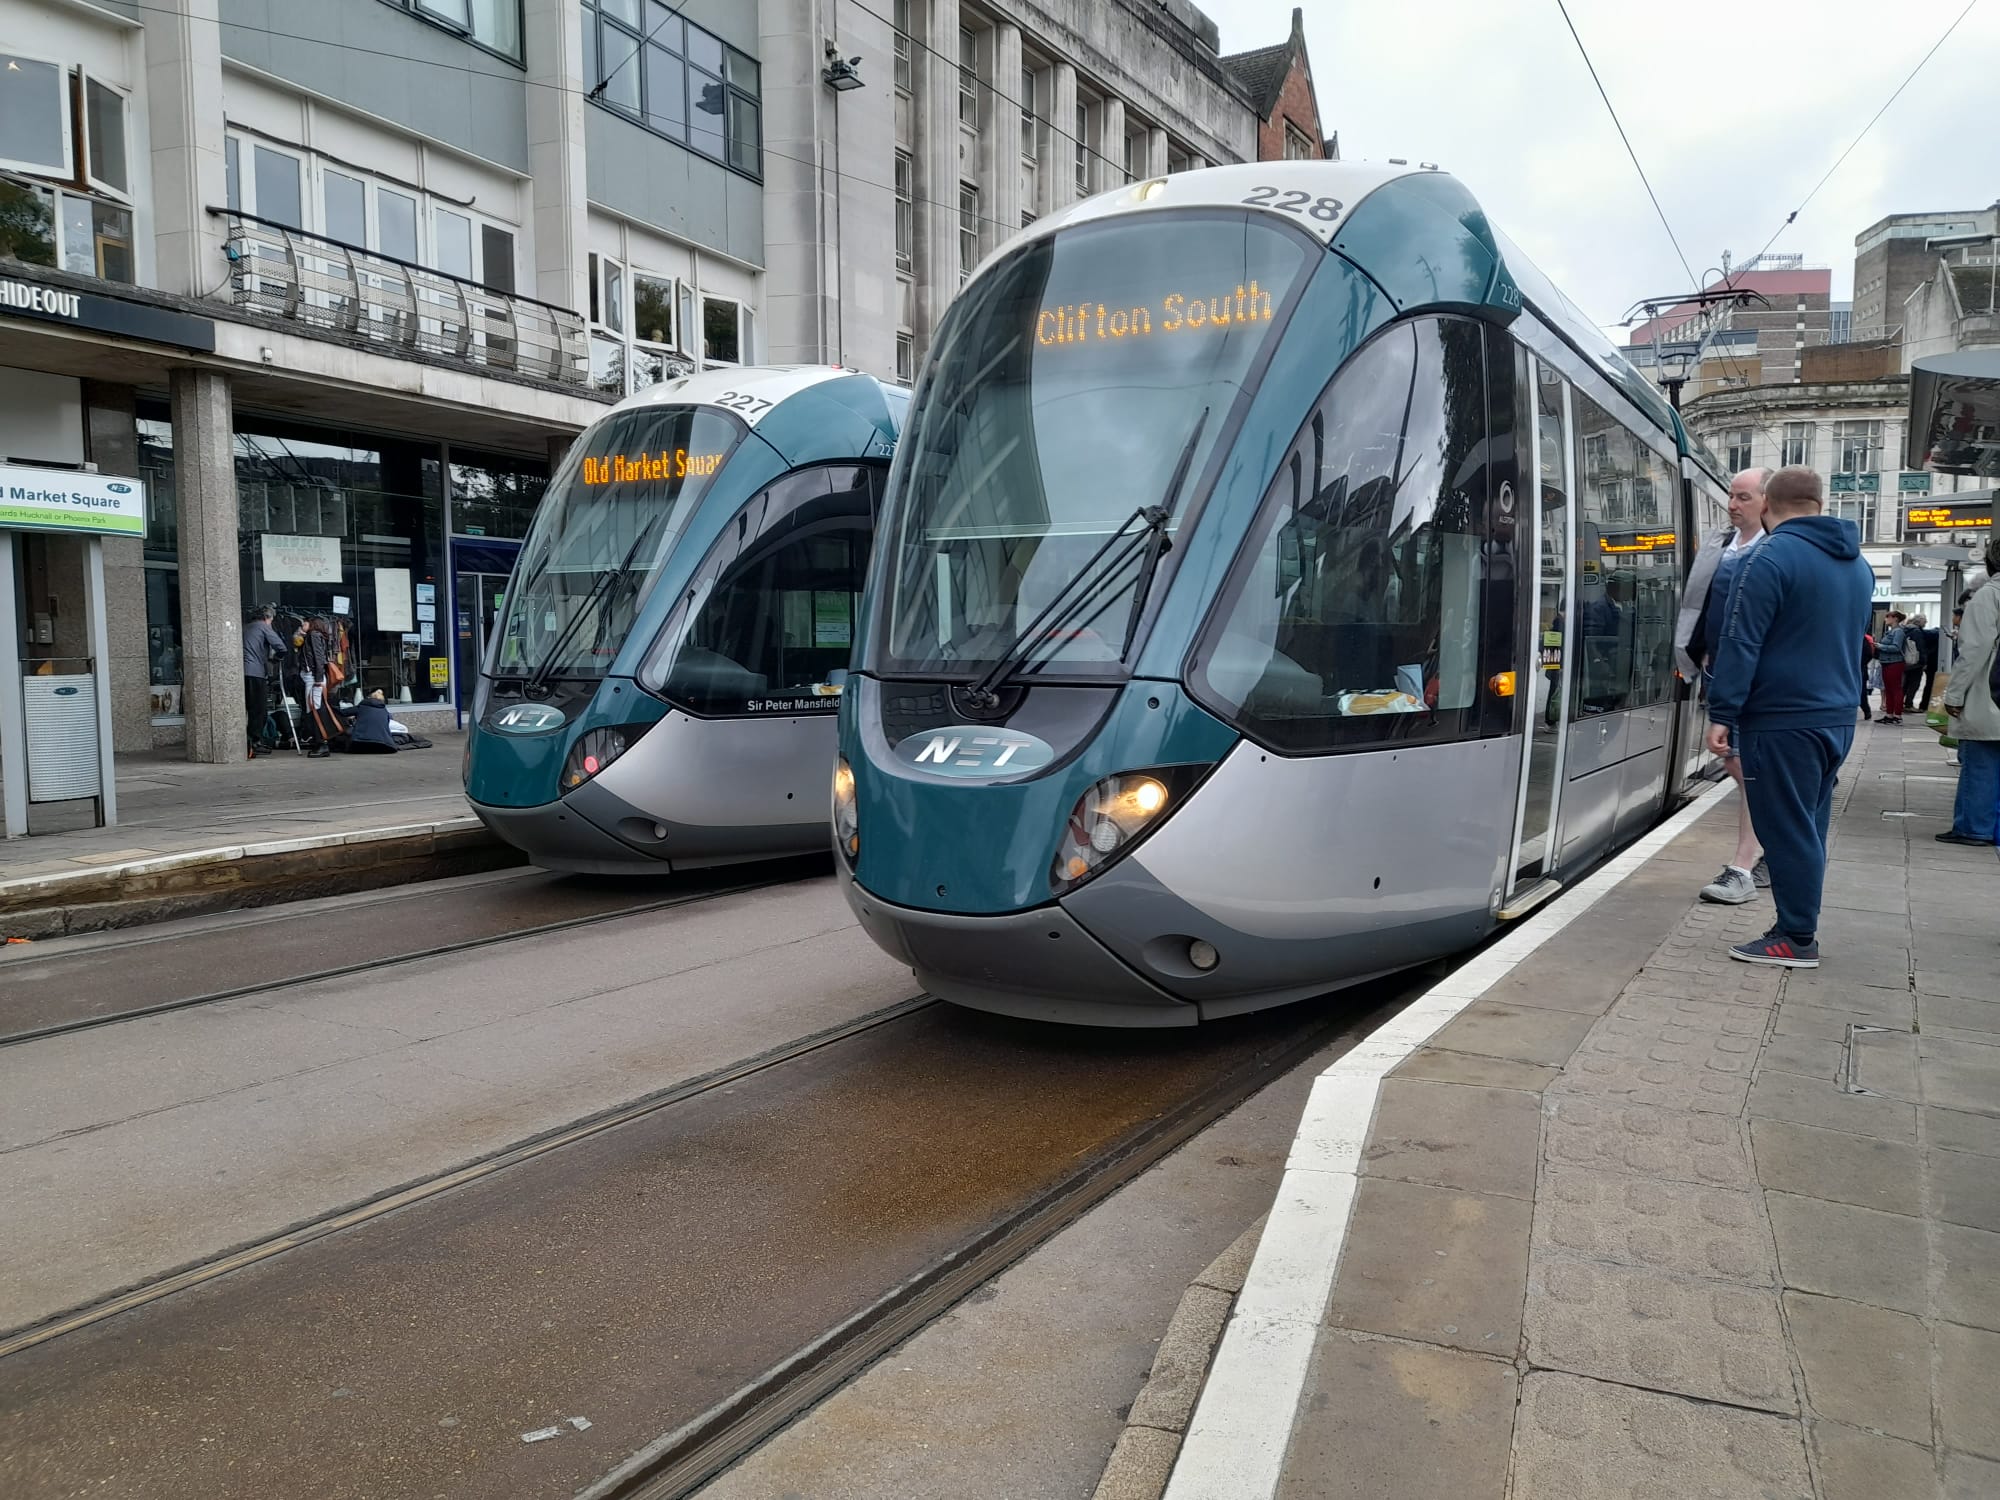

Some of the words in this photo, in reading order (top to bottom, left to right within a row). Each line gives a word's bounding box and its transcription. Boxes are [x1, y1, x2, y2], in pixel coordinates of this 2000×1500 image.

[1241, 186, 1344, 222] 228
[0, 280, 81, 318] HIDEOUT
[1501, 283, 1520, 308] 228
[1037, 302, 1151, 345] Clifton
[1163, 279, 1271, 331] South
[714, 391, 774, 414] 227
[584, 455, 610, 485] Old
[614, 450, 670, 482] Market
[675, 449, 723, 478] Squar
[10, 487, 67, 503] Market
[71, 492, 121, 508] Square
[20, 512, 53, 520] Hucknall
[92, 516, 106, 524] Park
[747, 700, 763, 711] Sir
[765, 700, 793, 711] Peter
[794, 697, 840, 710] Mansfield
[498, 709, 557, 727] NET
[913, 736, 1032, 767] NET
